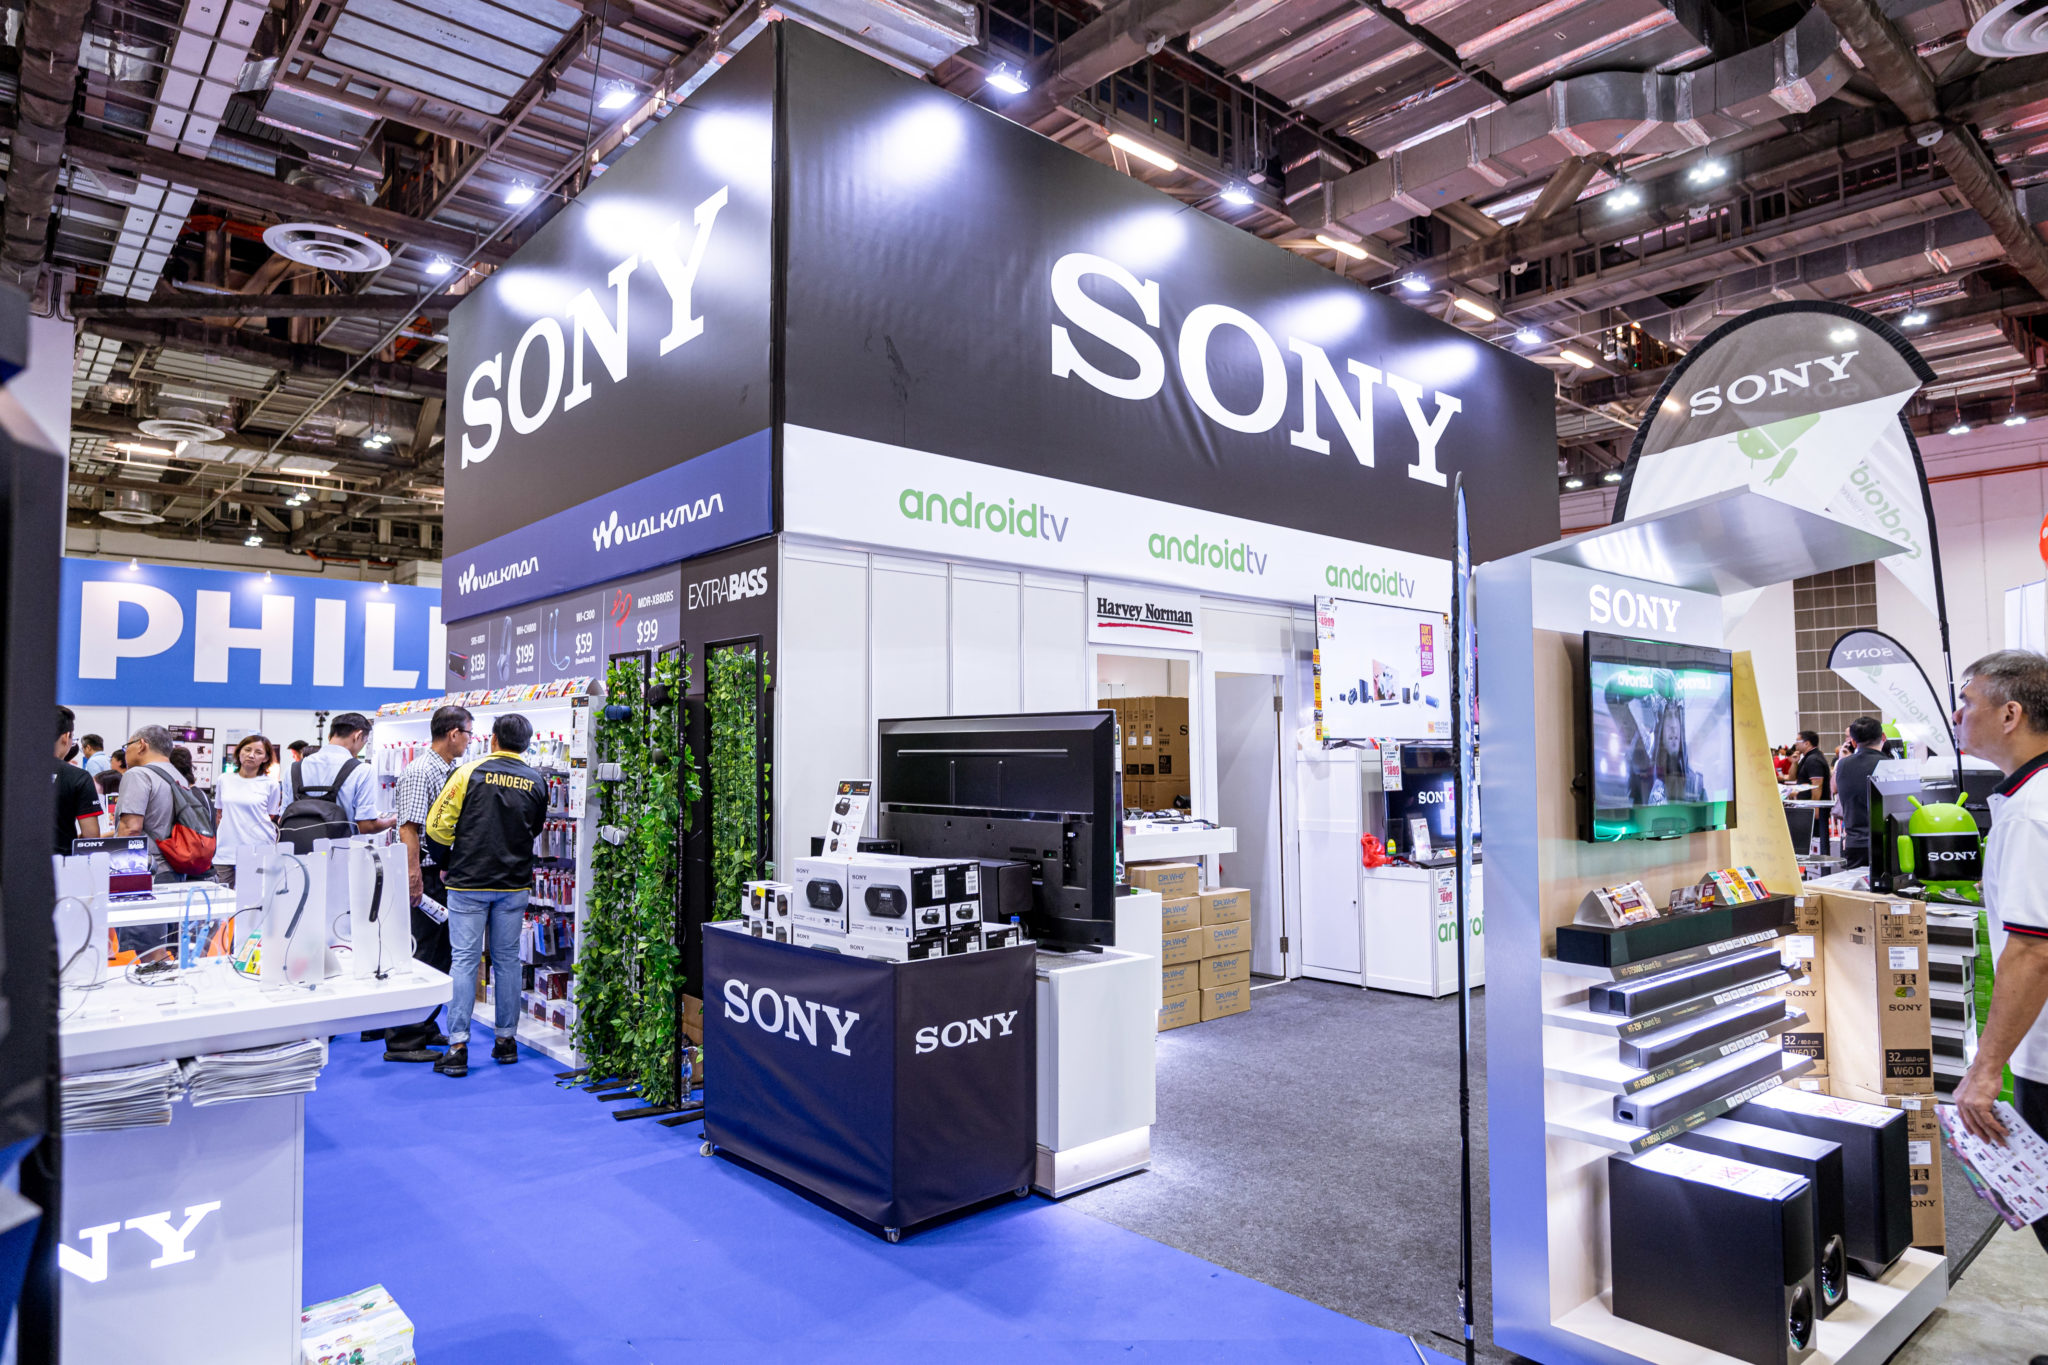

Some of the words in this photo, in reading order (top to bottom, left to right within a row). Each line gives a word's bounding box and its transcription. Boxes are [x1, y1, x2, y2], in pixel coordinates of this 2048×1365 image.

[461, 185, 728, 470] SONY
[1050, 252, 1462, 487] SONY
[1689, 350, 1859, 418] SONY
[624, 493, 724, 543] WALKMAN
[899, 488, 1069, 542] androidtv
[1148, 532, 1268, 576] androidtv
[479, 556, 539, 590] WALKMAN
[1325, 564, 1415, 599] androidtv
[1096, 597, 1143, 622] Harvey
[1145, 602, 1194, 625] Norman
[1589, 584, 1681, 632] SONY
[78, 581, 447, 690] PHILI
[575, 632, 593, 656] $59
[637, 618, 659, 645] $99
[470, 653, 485, 673] $139
[516, 643, 535, 667] $199
[485, 772, 535, 792] CANOEIST
[1418, 791, 1451, 804] SONY
[1927, 851, 1977, 861] SONY
[724, 978, 860, 1057] SONY
[915, 1009, 1018, 1054] SONY
[1784, 1035, 1796, 1045] 32
[1888, 1052, 1900, 1062] 32
[1893, 1067, 1914, 1075] W60
[58, 1200, 221, 1283] NY
